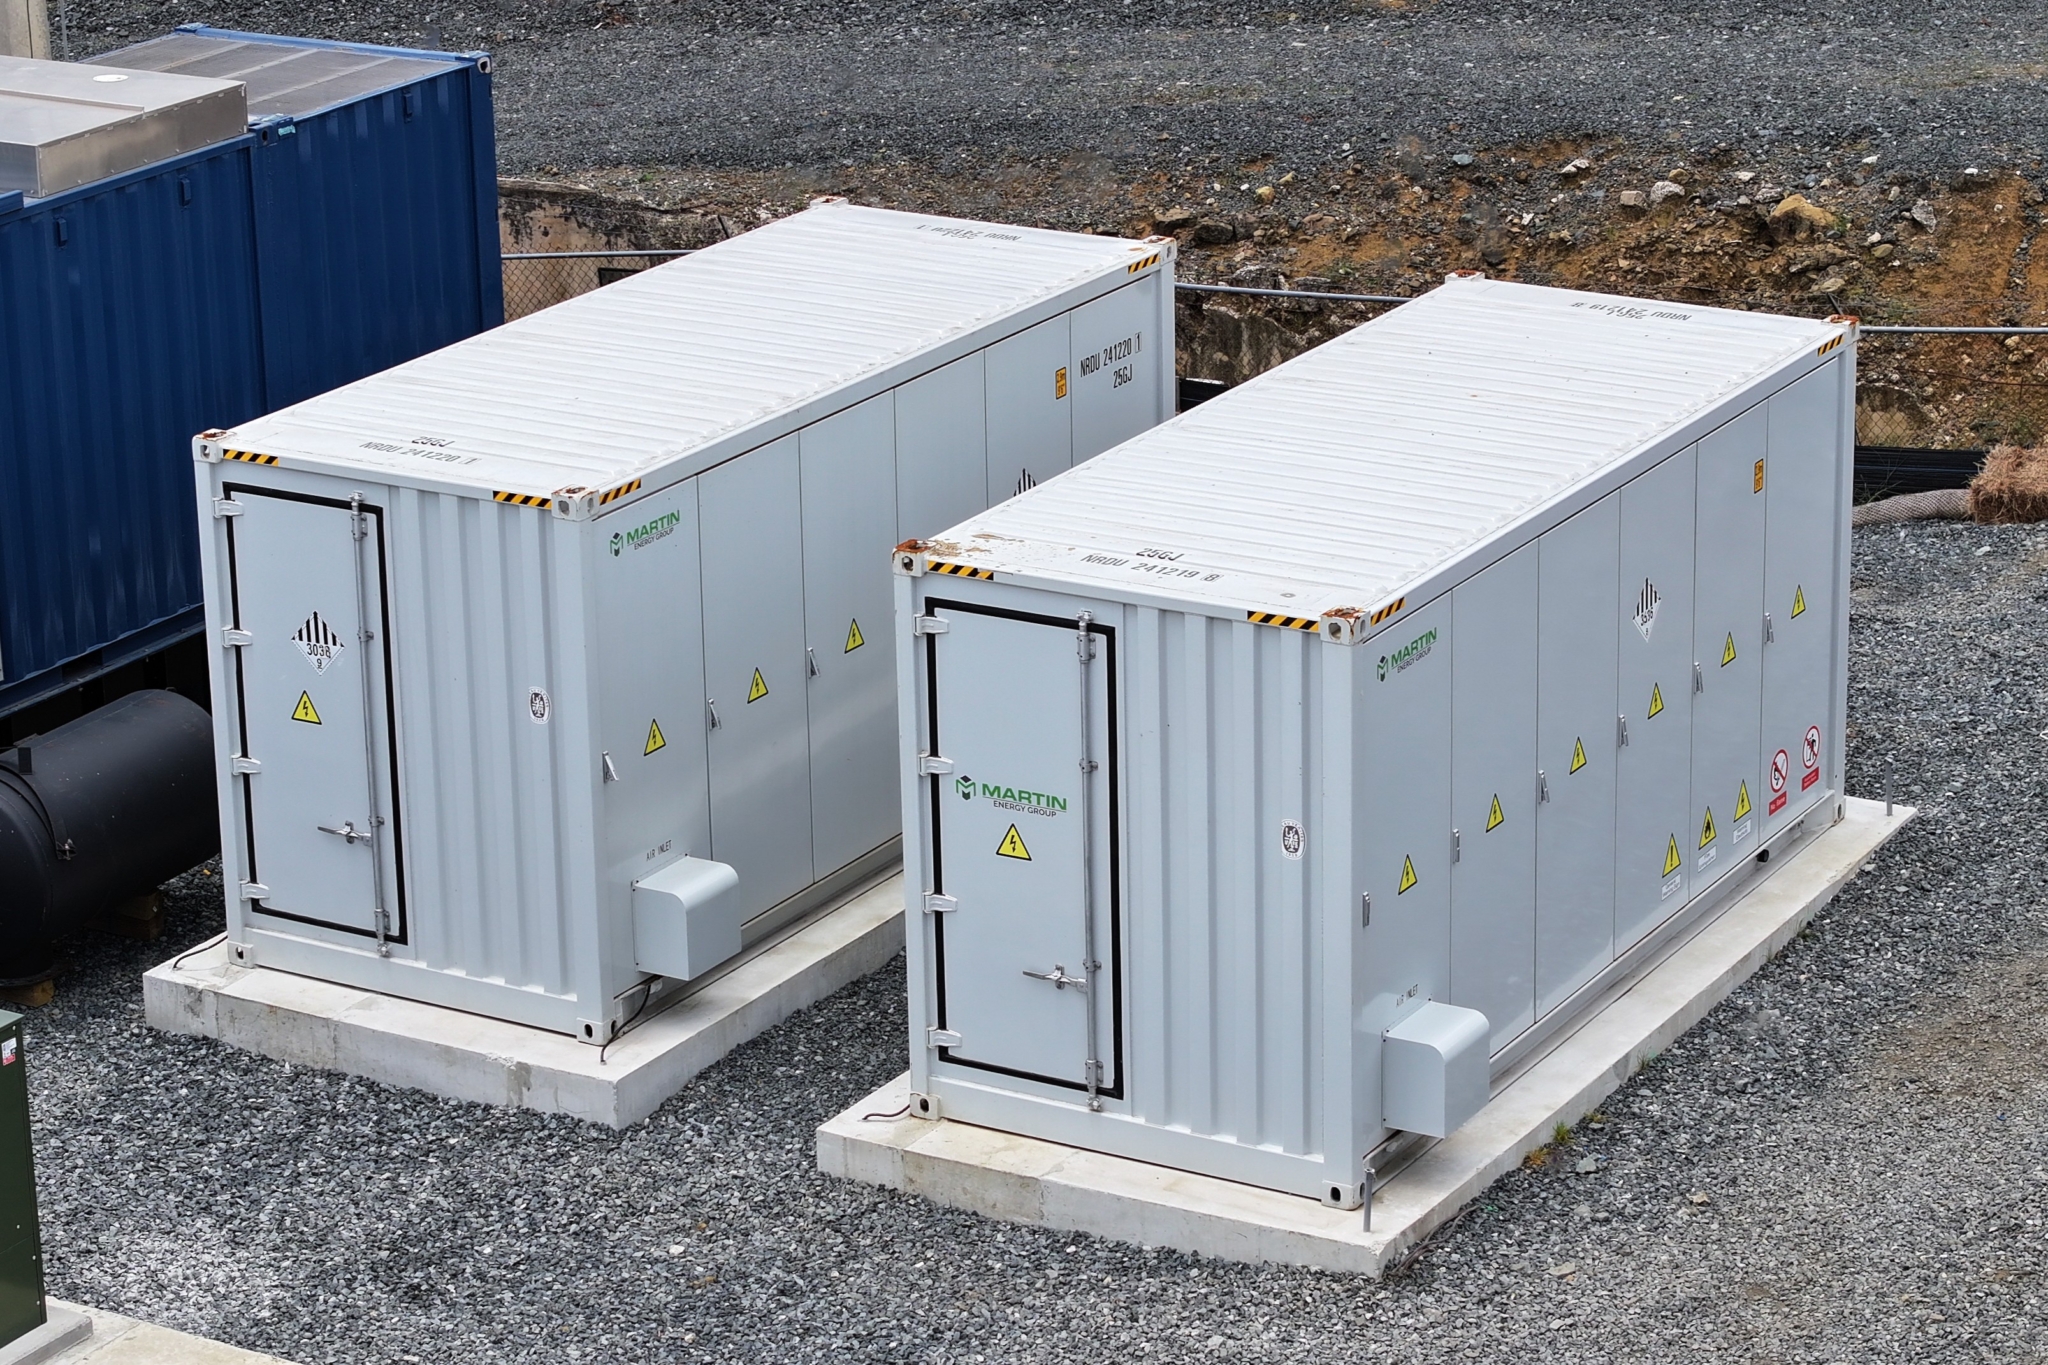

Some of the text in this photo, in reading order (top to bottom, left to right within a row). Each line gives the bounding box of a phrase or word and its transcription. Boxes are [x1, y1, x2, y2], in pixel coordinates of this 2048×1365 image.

[1080, 352, 1100, 378] NRDU
[1103, 337, 1132, 366] 241220
[1113, 363, 1133, 389] 25GJ
[359, 441, 402, 453] NRDU
[399, 448, 461, 462] 241220
[411, 436, 455, 448] 25GJ
[626, 509, 680, 544] MARTIN
[634, 527, 674, 550] ENERGY GROUP
[1135, 547, 1185, 561] 25GJ
[1080, 554, 1129, 567] NRDU
[1130, 562, 1200, 578] 241219
[1391, 626, 1437, 667] MARTIN
[1397, 646, 1432, 673] ENERGY GROUP
[982, 783, 1067, 811] MARTIN
[993, 800, 1057, 818] ENERGY GROUP
[646, 839, 672, 862] AIR INLET
[1405, 983, 1418, 1001] INLET
